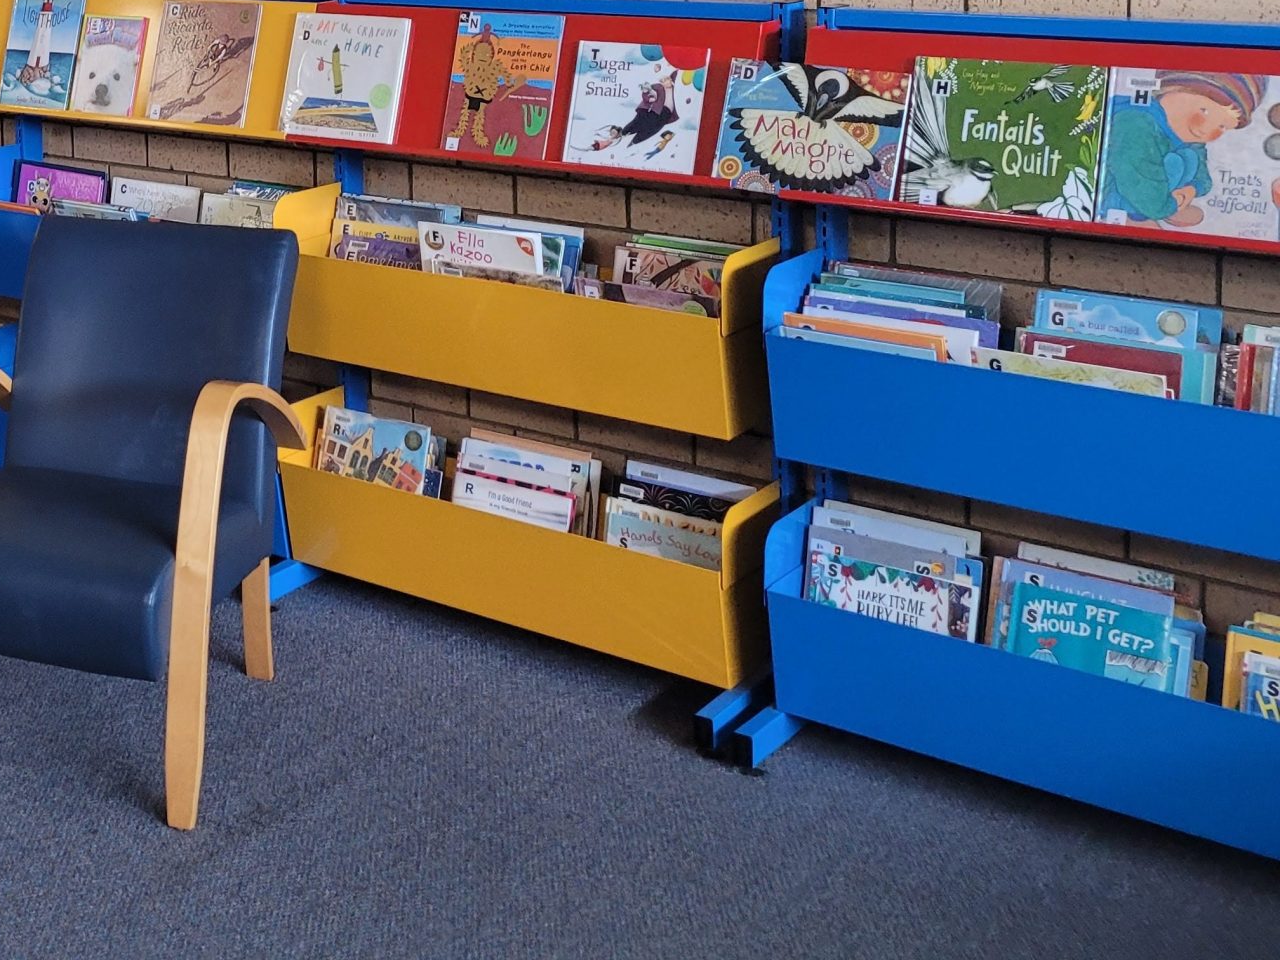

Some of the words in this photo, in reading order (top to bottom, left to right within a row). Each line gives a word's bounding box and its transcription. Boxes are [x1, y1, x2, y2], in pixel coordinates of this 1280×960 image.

[22, 2, 72, 29] LIGHTHOUSE
[172, 6, 179, 16] C
[470, 19, 479, 29] N
[303, 30, 310, 40] D
[172, 34, 207, 54] Ride!
[344, 38, 384, 59] HOME
[497, 47, 553, 59] Pangkarlangu
[591, 49, 600, 61] T
[510, 62, 527, 71] Lost
[530, 64, 551, 73] Child
[589, 58, 634, 76] Sugar
[743, 67, 754, 80] D
[601, 75, 617, 84] and
[585, 81, 629, 99] Snails
[936, 81, 949, 95] H
[1135, 91, 1149, 105] H
[753, 114, 810, 141] Mad
[961, 109, 1045, 146] Fantail's
[771, 138, 855, 175] Magpie
[1001, 146, 1062, 178] Quilt
[1219, 170, 1262, 187] That's
[28, 182, 35, 191] C
[121, 184, 127, 194] C
[1222, 186, 1247, 197] not
[1251, 189, 1261, 198] a
[347, 205, 354, 215] E
[1207, 196, 1268, 214] daffodil!
[343, 224, 350, 235] E
[458, 231, 484, 248] Ella
[450, 241, 493, 264] Kazoo
[347, 251, 356, 261] E
[358, 251, 422, 271] ometimes
[629, 258, 637, 270] F
[1051, 312, 1064, 326] G
[1088, 321, 1106, 330] bus
[1107, 324, 1140, 336] called
[989, 358, 1002, 371] G
[333, 424, 341, 435] R
[571, 464, 581, 474] R
[465, 483, 474, 494] R
[619, 538, 628, 549] S
[621, 527, 662, 545] Hands
[667, 536, 692, 557] Say
[828, 564, 838, 577] S
[916, 565, 931, 575] S
[857, 590, 886, 603] HARK
[907, 598, 926, 617] ME
[1026, 609, 1037, 624] S
[1027, 599, 1078, 617] WHAT
[1086, 605, 1119, 625] PET
[1028, 617, 1091, 638] SHOULD
[1096, 626, 1103, 640] I
[1108, 629, 1155, 653] GET?
[1267, 680, 1280, 698] S
